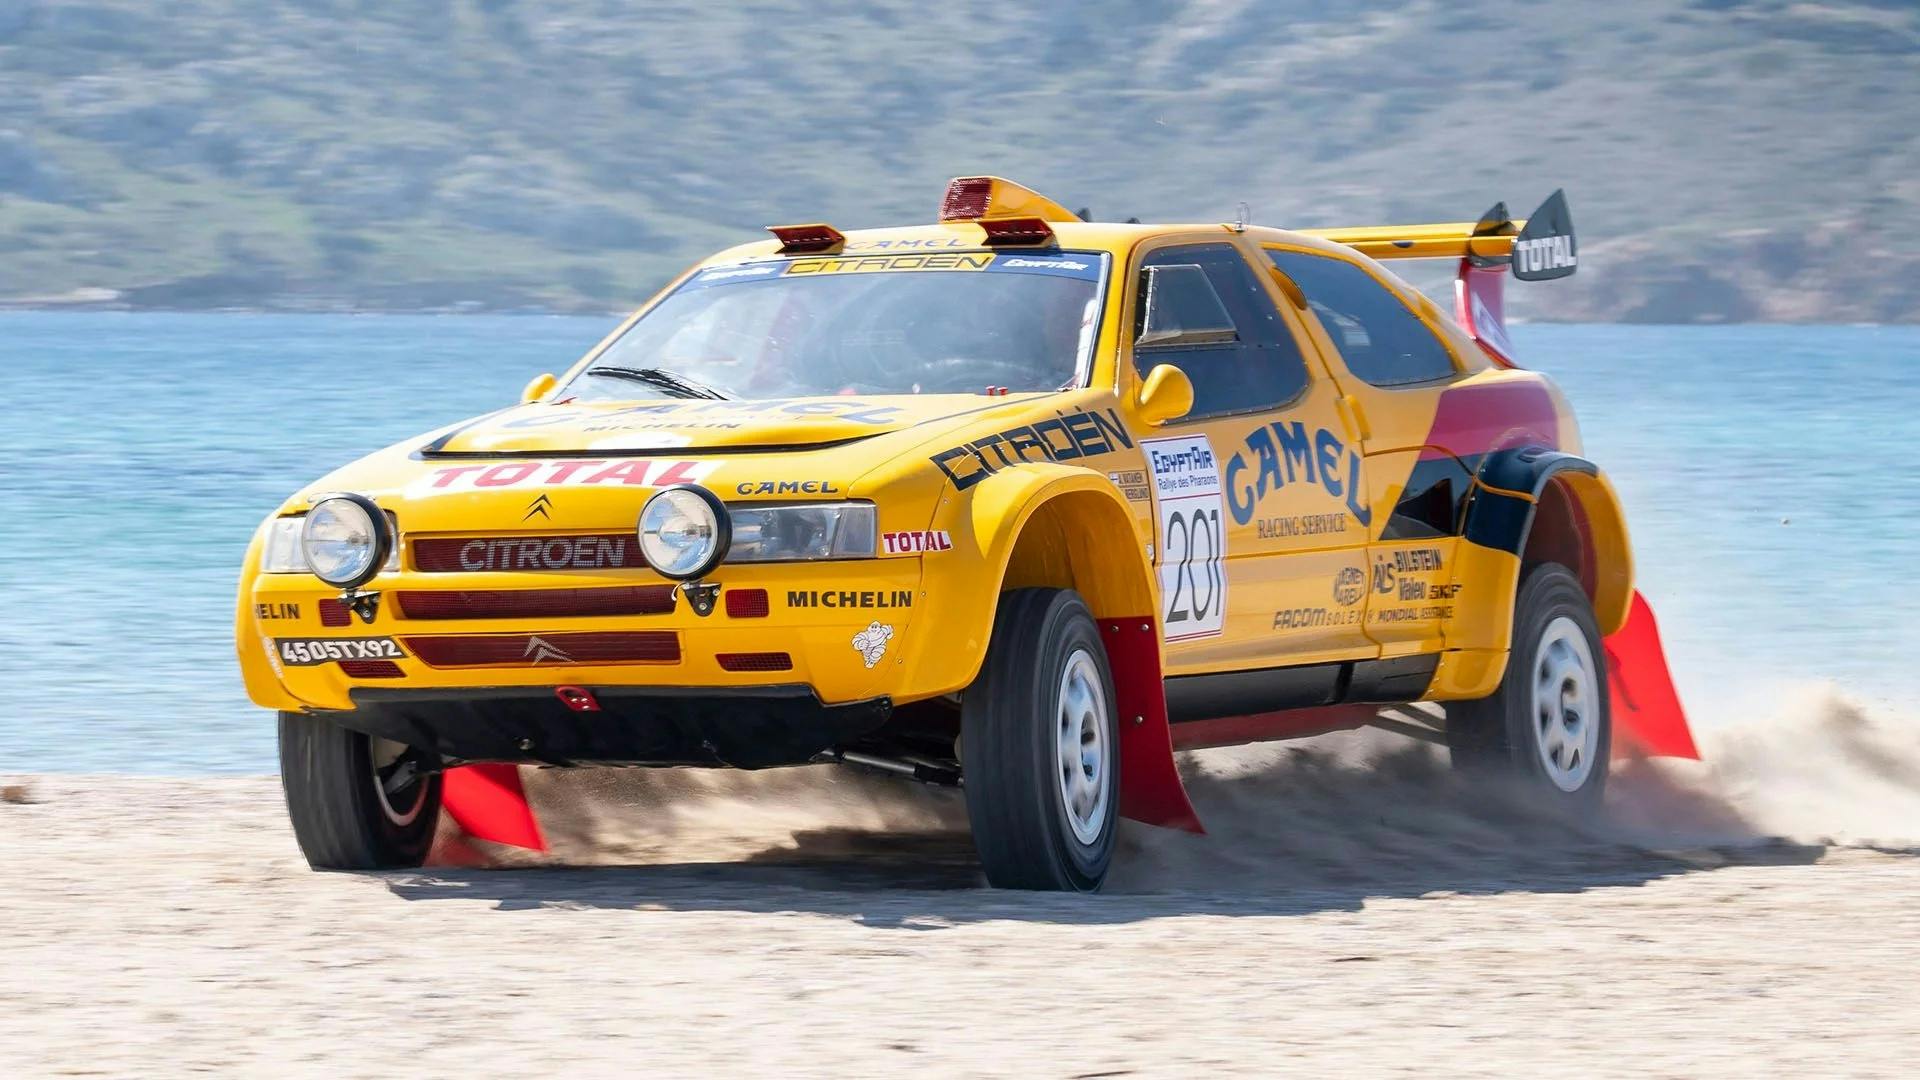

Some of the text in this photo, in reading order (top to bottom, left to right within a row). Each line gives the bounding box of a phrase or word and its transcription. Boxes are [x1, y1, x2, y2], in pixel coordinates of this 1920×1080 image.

[844, 237, 967, 250] CAMEL
[1517, 235, 1576, 273] TOTAL
[432, 460, 701, 488] TOTAL
[1158, 475, 1218, 492] Rallye des Pharaons
[1226, 421, 1372, 527] CAMEL
[736, 481, 838, 495] CAMEL
[1257, 512, 1346, 539] RACING SERVICE
[883, 531, 952, 553] TOTAL
[460, 537, 625, 571] CITROEN
[1394, 549, 1442, 572] BILSTEIN
[1165, 507, 1221, 624] 201
[787, 590, 912, 608] MICHELIN
[1429, 584, 1462, 600] SKF
[1273, 607, 1328, 630] FACOM
[1326, 609, 1364, 626] SOLEX
[1378, 607, 1418, 624] MONDIAL
